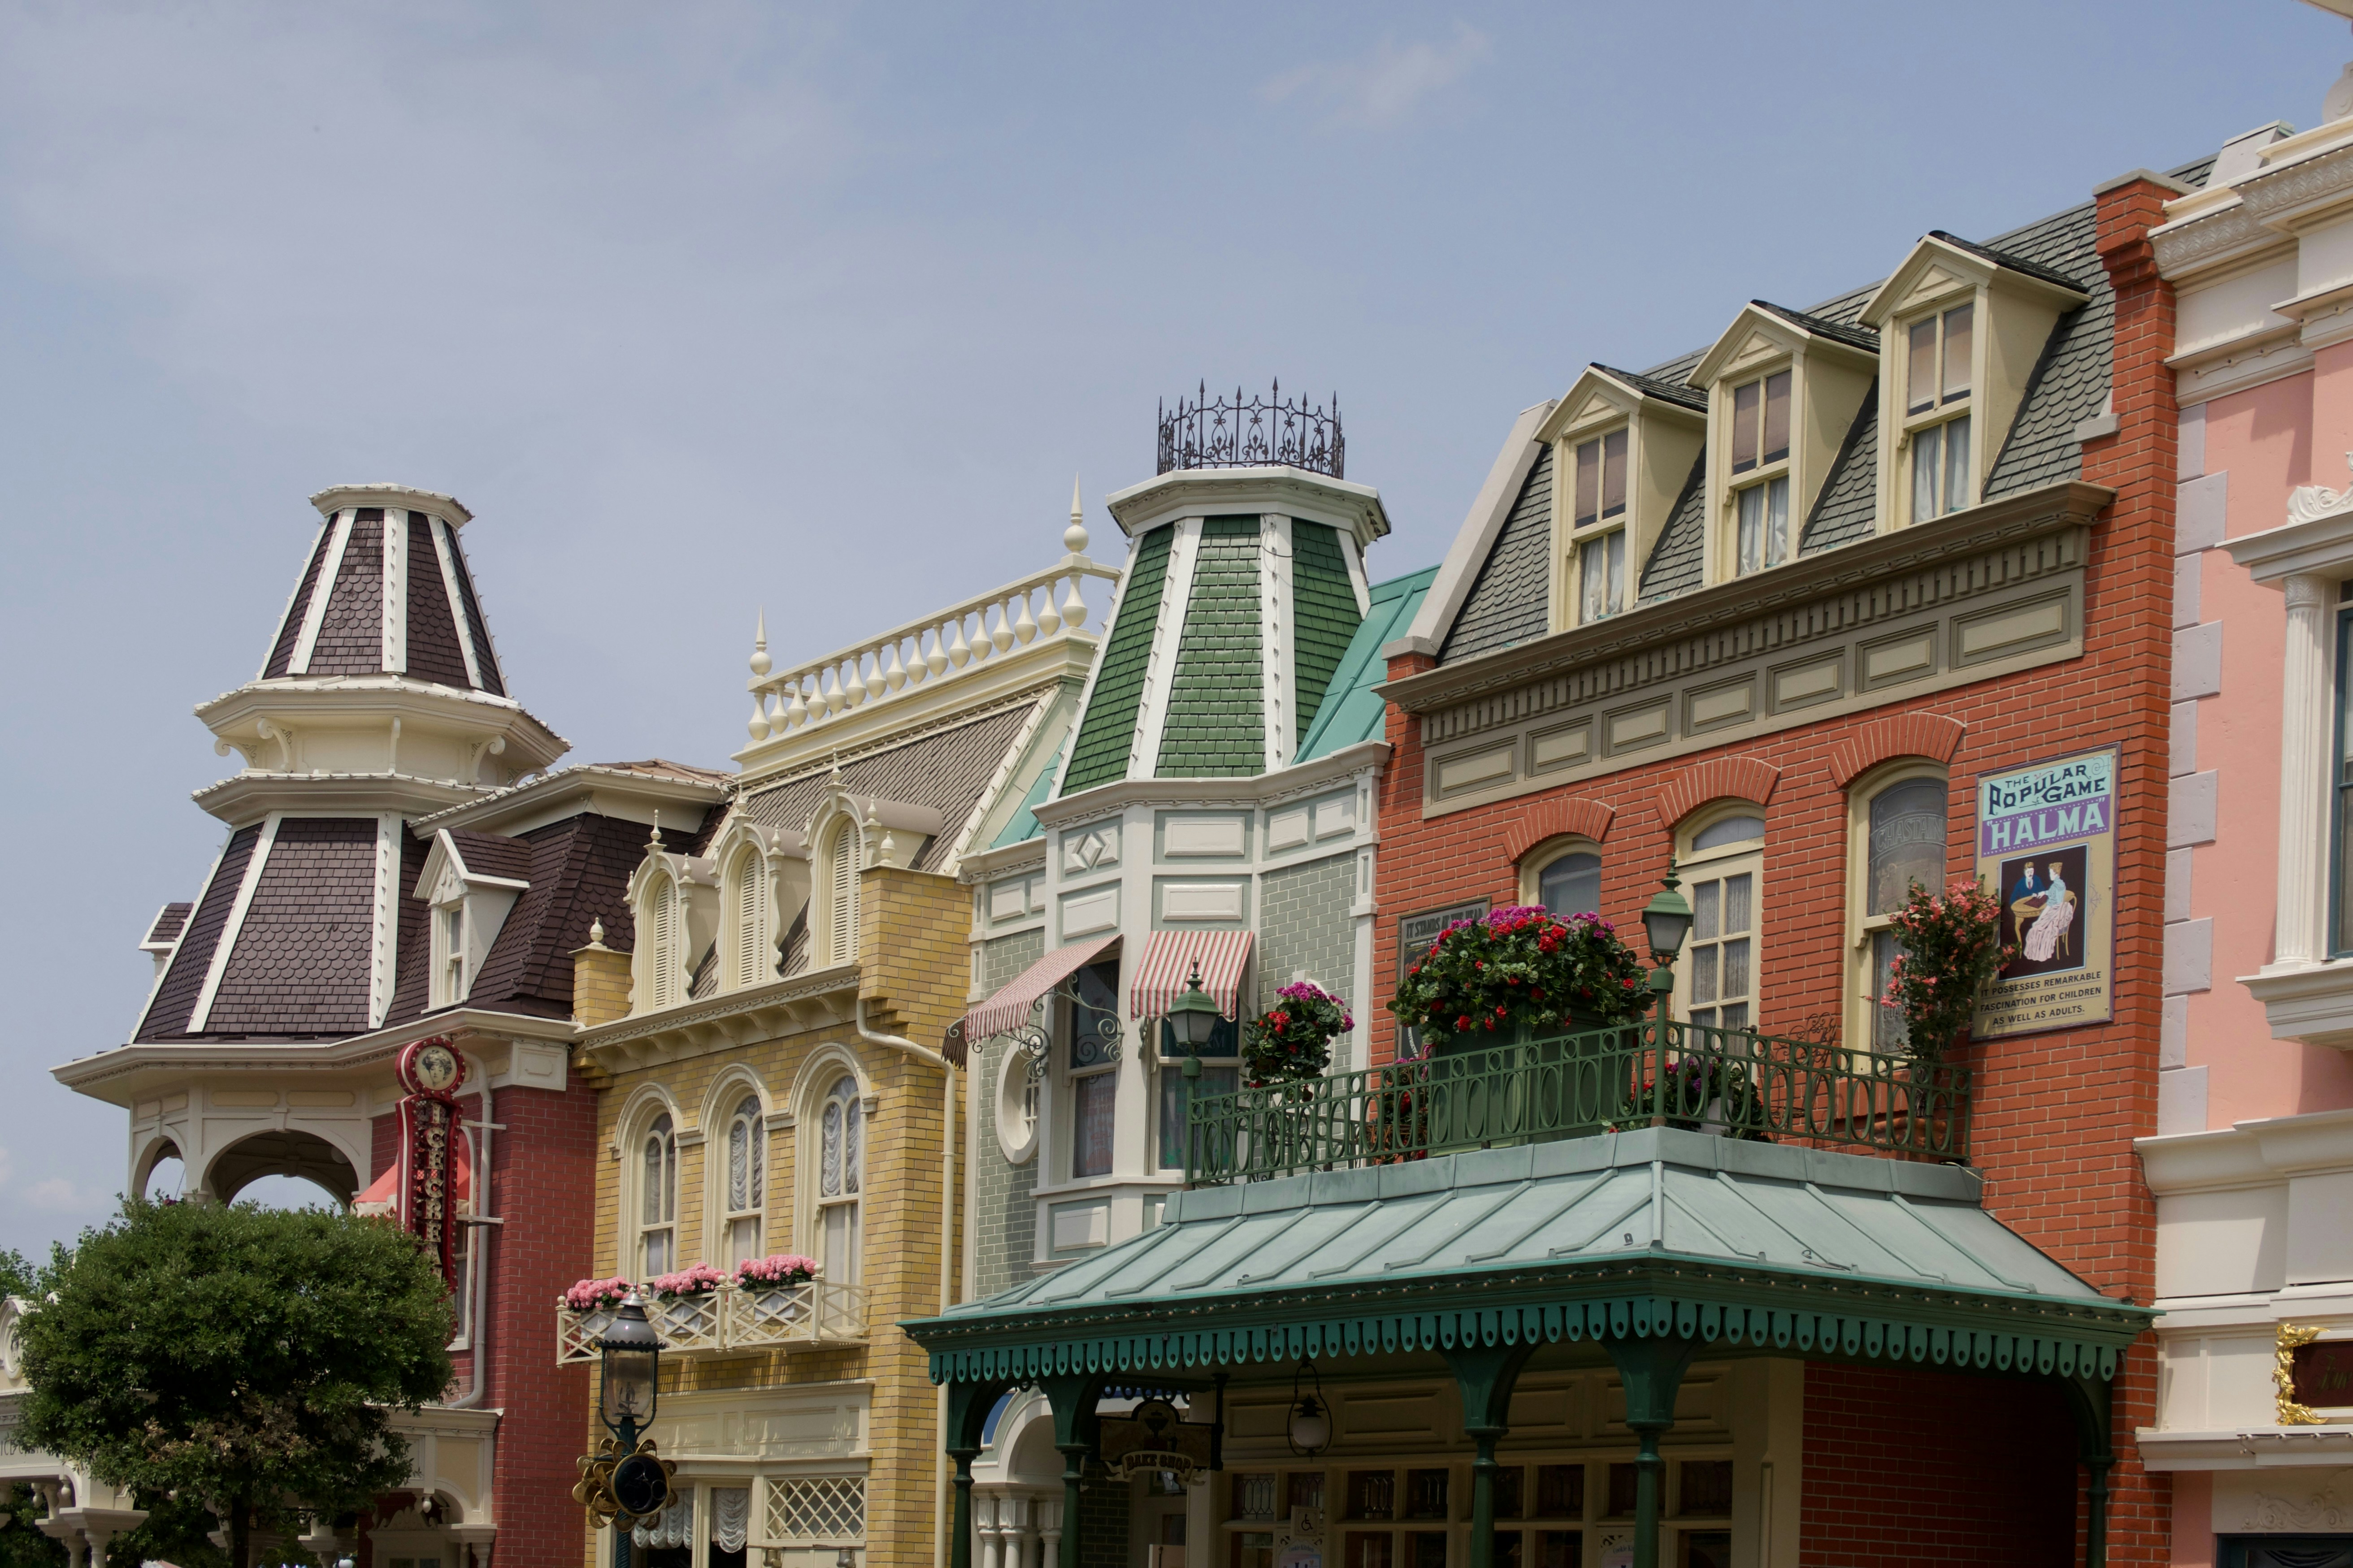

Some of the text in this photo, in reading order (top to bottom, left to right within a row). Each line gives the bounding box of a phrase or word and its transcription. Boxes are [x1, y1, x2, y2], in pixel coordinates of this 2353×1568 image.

[1988, 765, 2091, 816] POPULAR
[2005, 775, 2030, 788] THE
[2041, 776, 2107, 803] GAME
[1406, 923, 1415, 939] IT
[1415, 917, 1441, 937] STANDS
[1981, 971, 2101, 997] IT POSSESSES REMARKABLE
[1980, 987, 2101, 1013] FASCINATION FOR CHILDREN
[1992, 1005, 2085, 1026] AS WELL AS ADULTS.
[425, 1103, 445, 1170] ICE
[1125, 1454, 1191, 1474] BAKE SHOP
